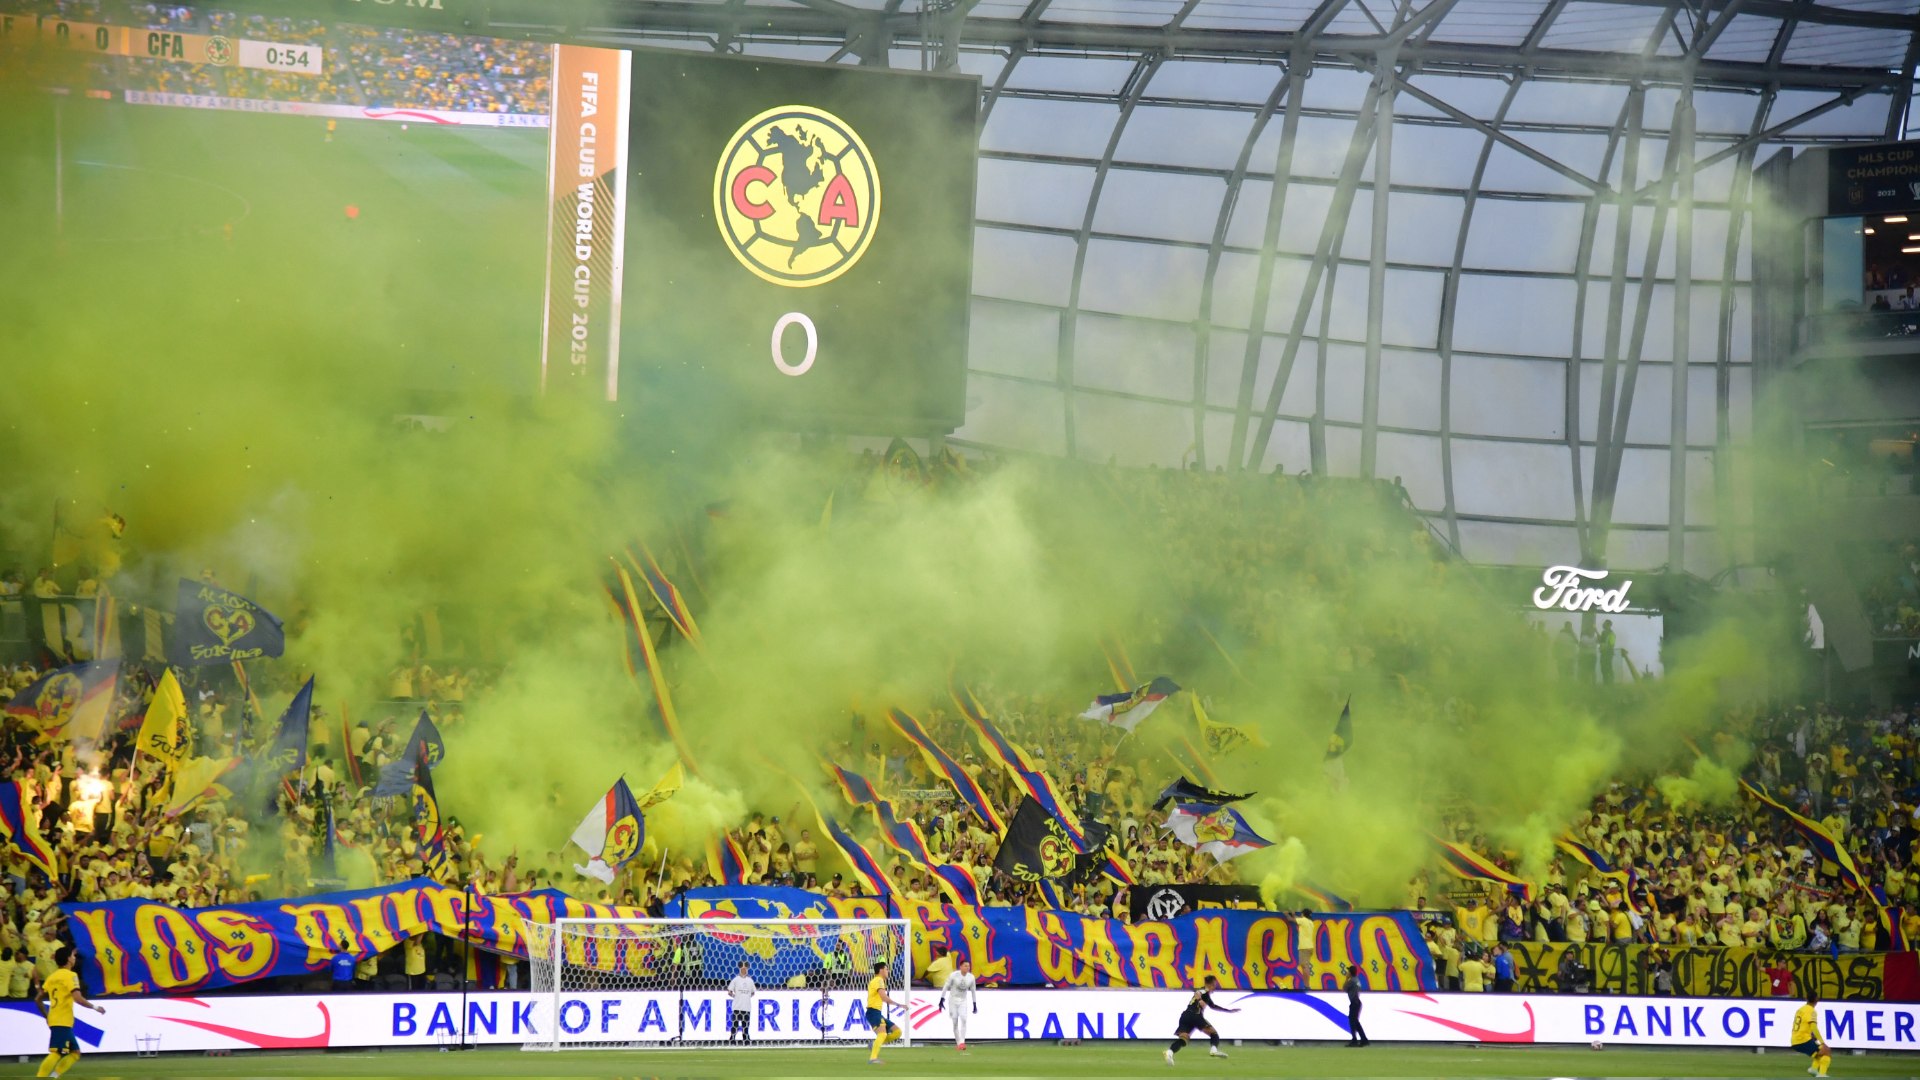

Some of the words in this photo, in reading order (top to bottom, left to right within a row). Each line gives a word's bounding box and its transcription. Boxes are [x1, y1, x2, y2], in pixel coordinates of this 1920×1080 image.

[96, 27, 108, 50] 0
[148, 33, 184, 58] CFA
[266, 47, 310, 67] 0:54
[581, 72, 598, 117] FIFA
[578, 122, 597, 177] CLUB
[1858, 152, 1885, 163] MLS
[1887, 150, 1915, 161] CUP
[575, 182, 594, 261] WORLD
[573, 264, 592, 309] CUP
[771, 312, 818, 377] 0
[1533, 565, 1633, 613] Ford
[73, 904, 274, 996] LOS
[392, 1000, 539, 1036] BANK
[560, 999, 621, 1034] OF
[1007, 1012, 1141, 1038] BANK
[1584, 1004, 1707, 1038] BANK
[1722, 1006, 1776, 1039] OF
